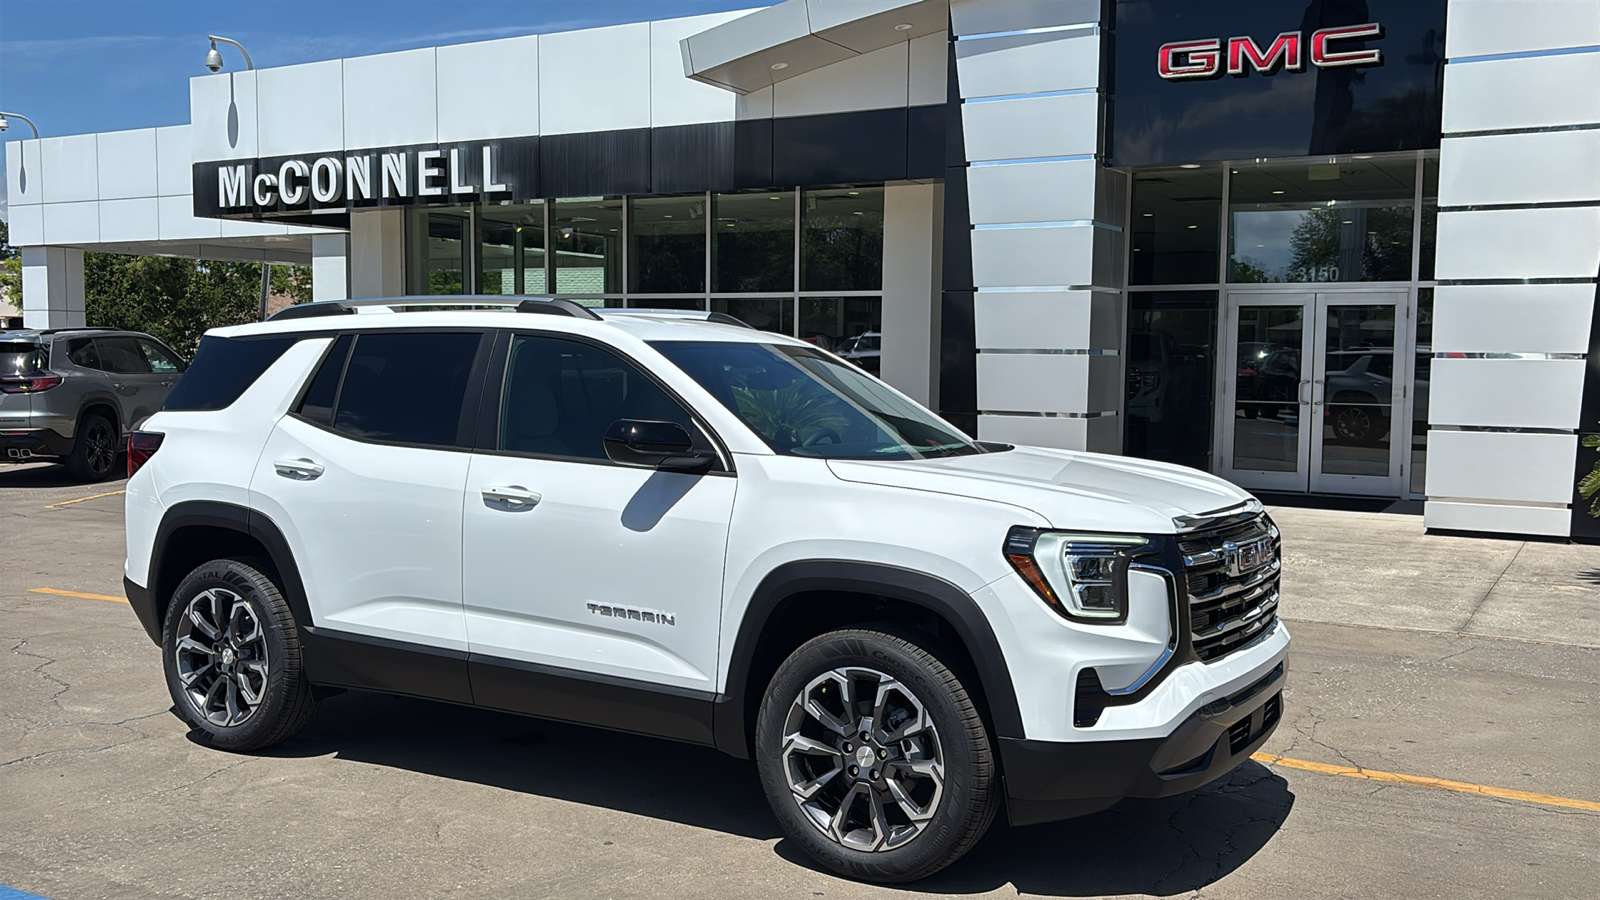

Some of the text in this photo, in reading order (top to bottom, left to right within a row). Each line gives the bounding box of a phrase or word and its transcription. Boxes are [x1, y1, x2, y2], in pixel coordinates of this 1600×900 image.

[1158, 23, 1381, 79] GMC
[1297, 266, 1340, 281] 3150
[1240, 538, 1275, 571] GMC
[586, 603, 675, 626] TERRAIN
